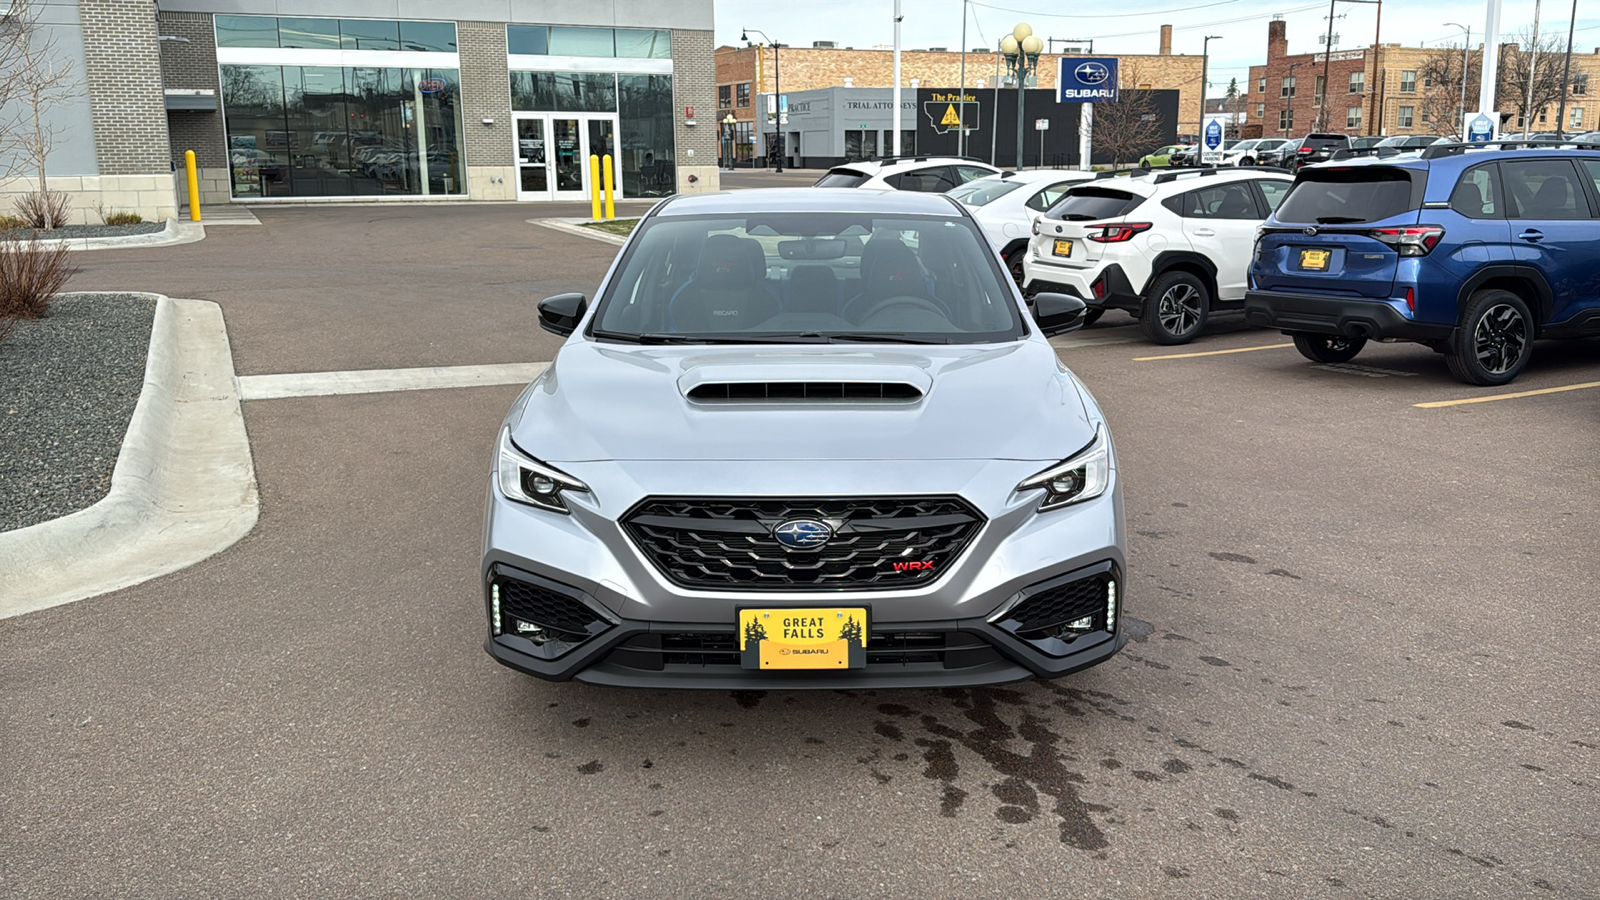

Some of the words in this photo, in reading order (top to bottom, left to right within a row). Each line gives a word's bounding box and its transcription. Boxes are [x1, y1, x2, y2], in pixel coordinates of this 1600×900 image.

[931, 92, 946, 102] The
[947, 92, 976, 102] Pratice
[1065, 88, 1114, 98] SUBARU
[847, 101, 872, 110] TRIAL
[872, 101, 917, 110] ATTONEYS
[893, 560, 934, 571] WRX
[783, 617, 824, 627] GREAT
[783, 628, 824, 639] FALLS
